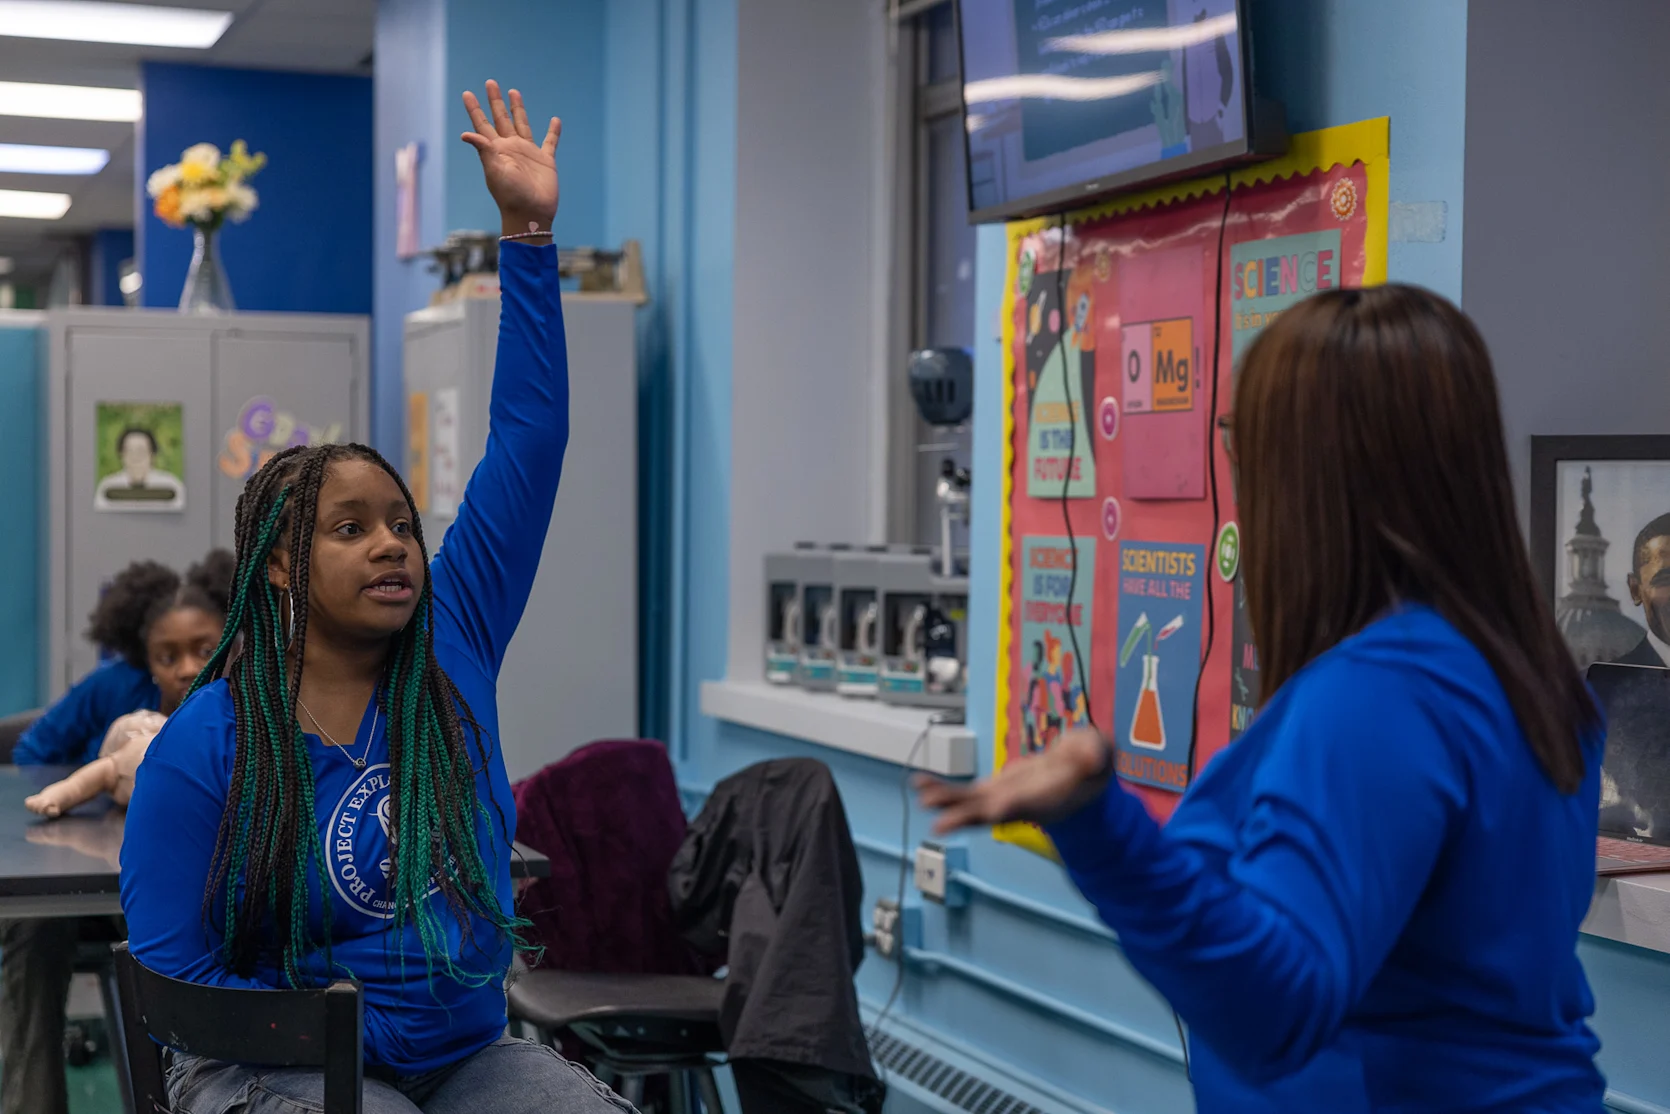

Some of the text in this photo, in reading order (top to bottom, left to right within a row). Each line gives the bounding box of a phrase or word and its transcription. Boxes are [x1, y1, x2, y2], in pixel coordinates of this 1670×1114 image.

[1234, 249, 1334, 300] SCIENCE
[1128, 349, 1141, 384] O
[1122, 548, 1196, 576] SCIENTISTS
[1147, 579, 1168, 598] ALL
[1170, 580, 1191, 600] THE
[1115, 749, 1189, 788] SOLUTIONS
[336, 774, 391, 904] PROJECT EXPL
